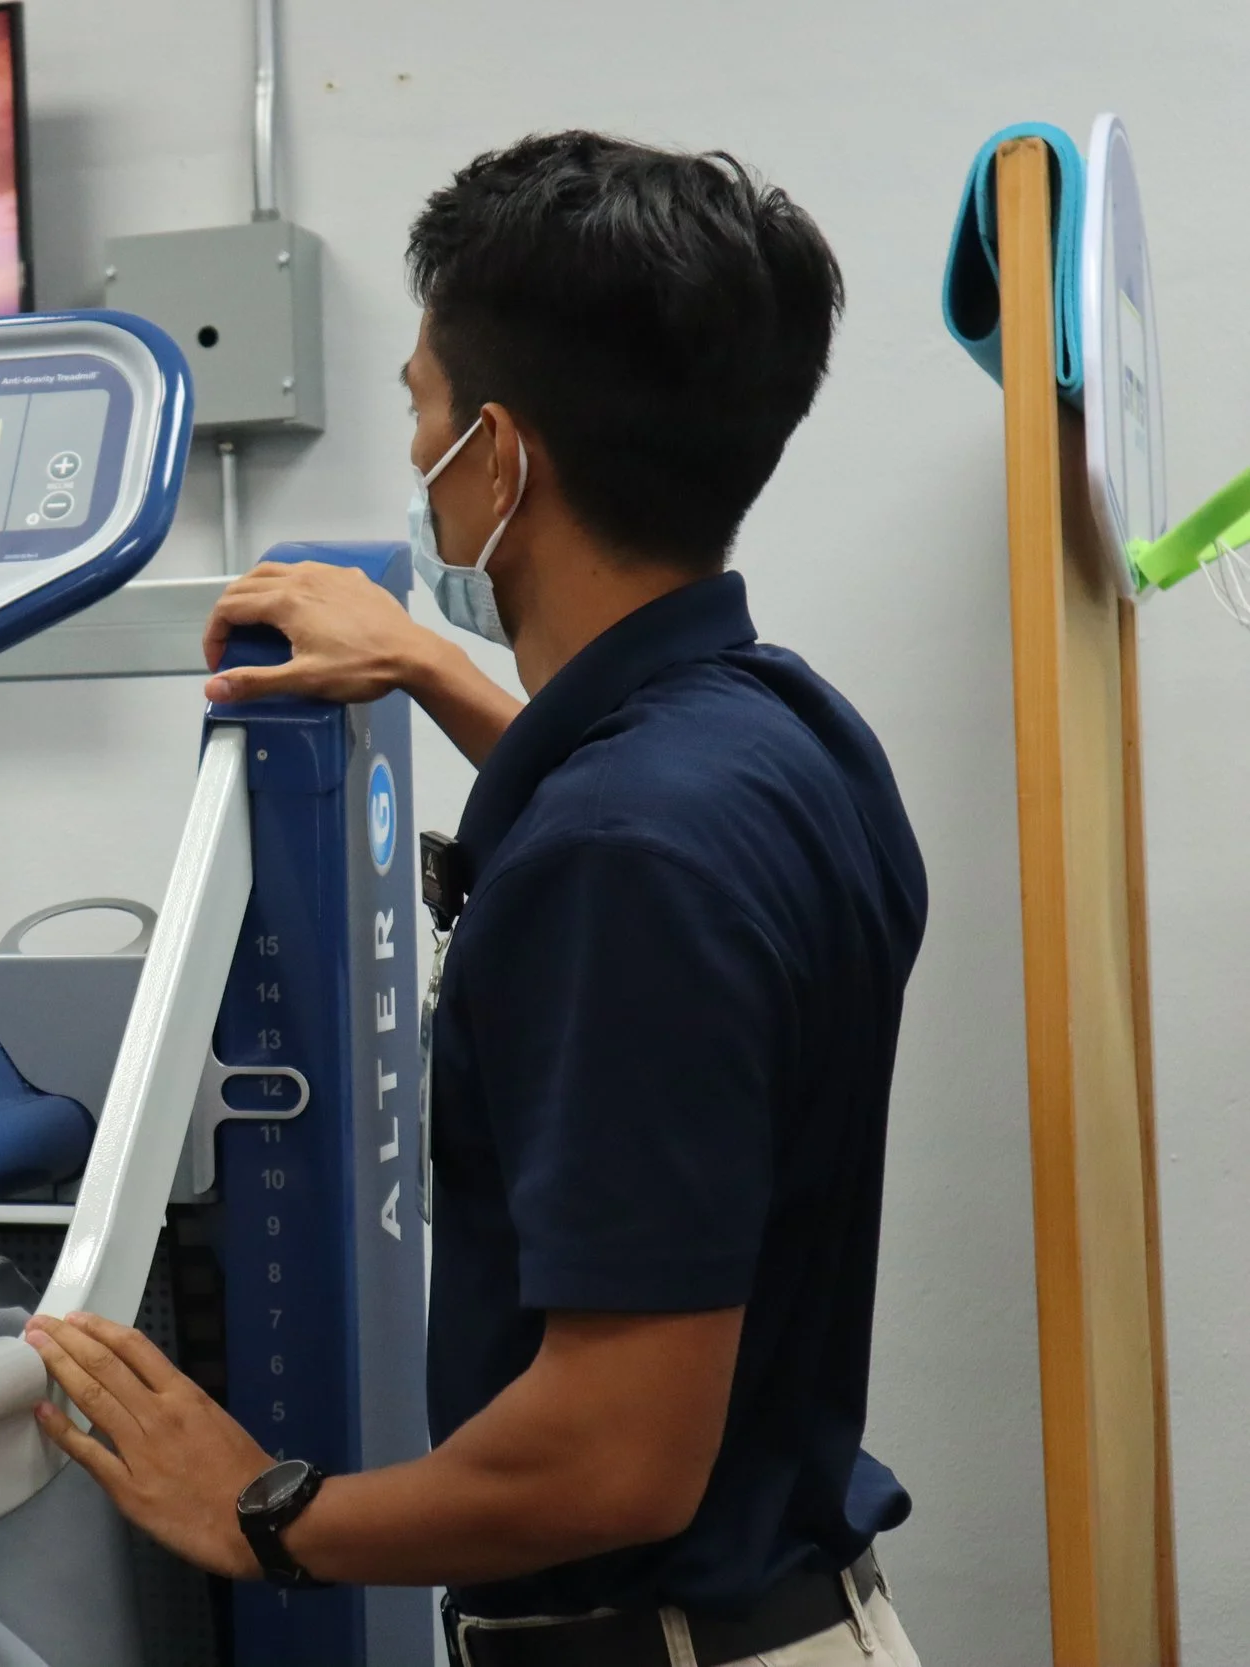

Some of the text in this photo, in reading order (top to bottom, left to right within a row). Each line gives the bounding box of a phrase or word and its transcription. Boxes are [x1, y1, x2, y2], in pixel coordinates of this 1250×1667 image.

[1, 374, 55, 385] Anti-Gravity
[57, 371, 97, 382] Treadmill
[255, 936, 279, 956] 15
[256, 983, 281, 1003] 14
[257, 1029, 282, 1050] 13
[375, 907, 401, 1241] ALTER
[259, 1076, 283, 1096] 12
[260, 1124, 281, 1143] 11
[261, 1169, 285, 1190] 10
[266, 1216, 281, 1236] 9
[268, 1263, 282, 1283] 8
[269, 1310, 282, 1329] 7
[270, 1355, 284, 1375] 6
[271, 1401, 285, 1422] 5
[278, 1588, 287, 1608] 1
